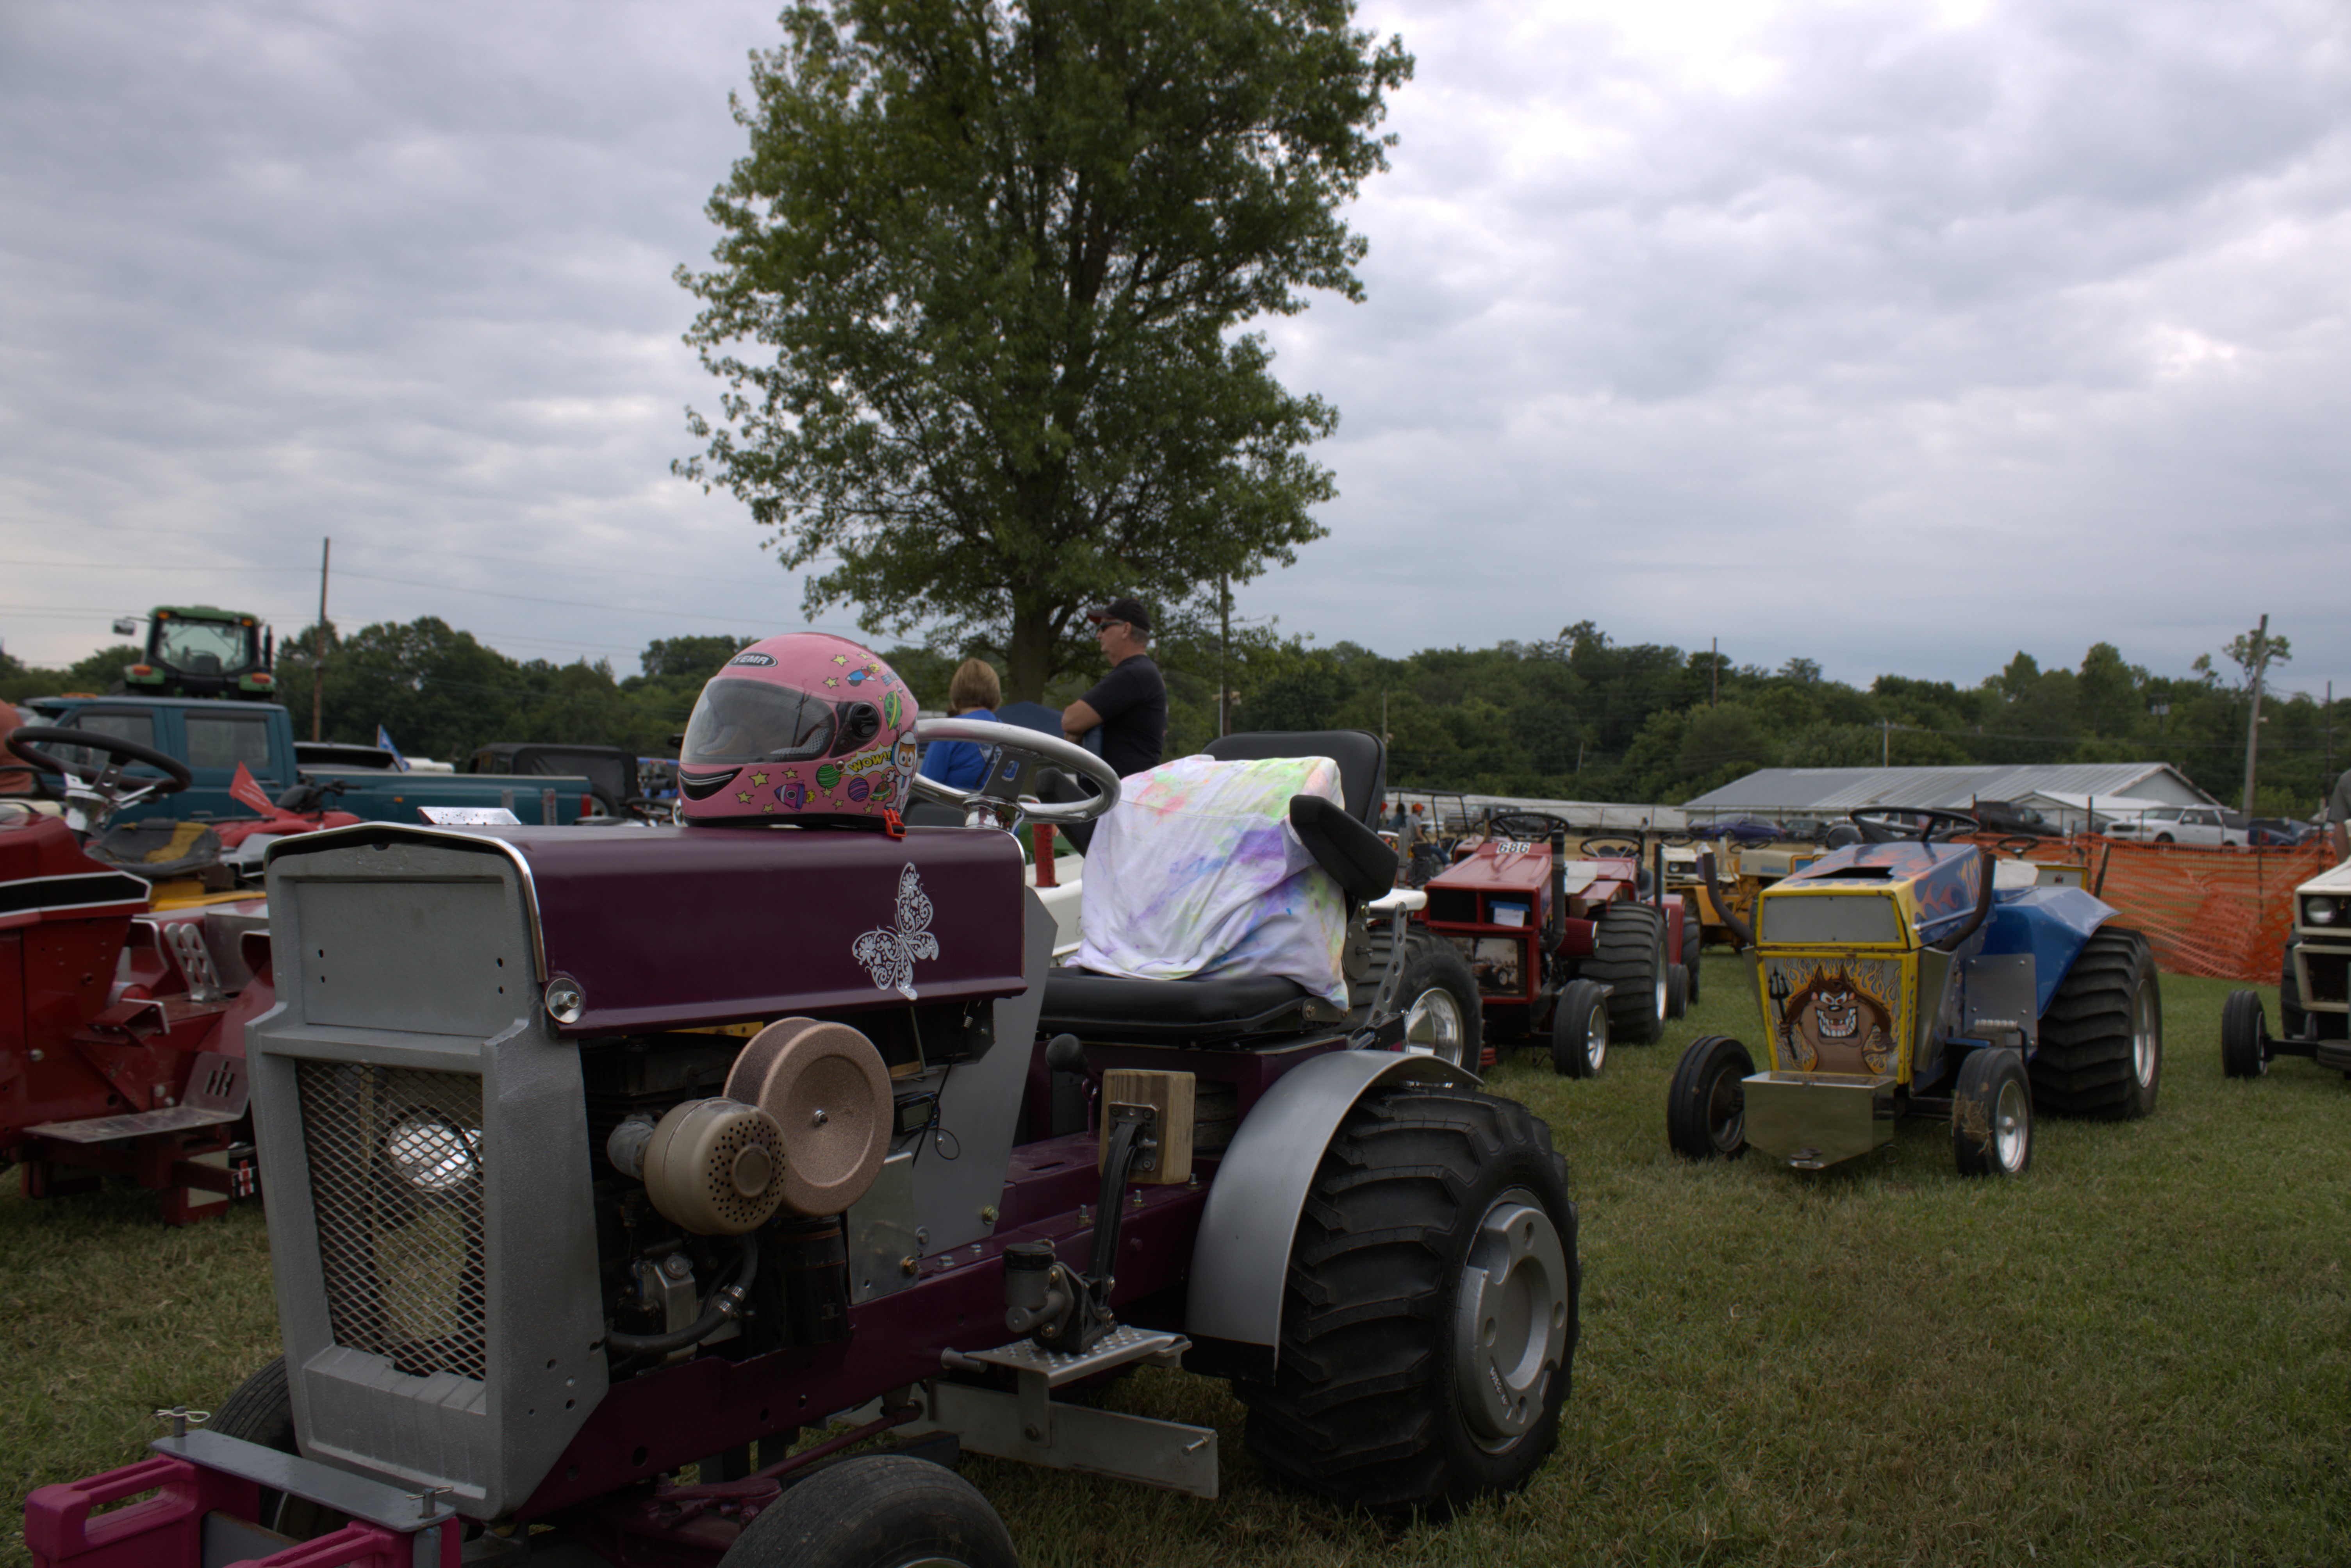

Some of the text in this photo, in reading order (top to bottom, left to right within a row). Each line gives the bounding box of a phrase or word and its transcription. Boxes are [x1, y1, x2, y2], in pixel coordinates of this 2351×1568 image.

[734, 655, 769, 664] YEMA
[847, 751, 892, 772] WOW!!
[1499, 843, 1529, 853] 686
